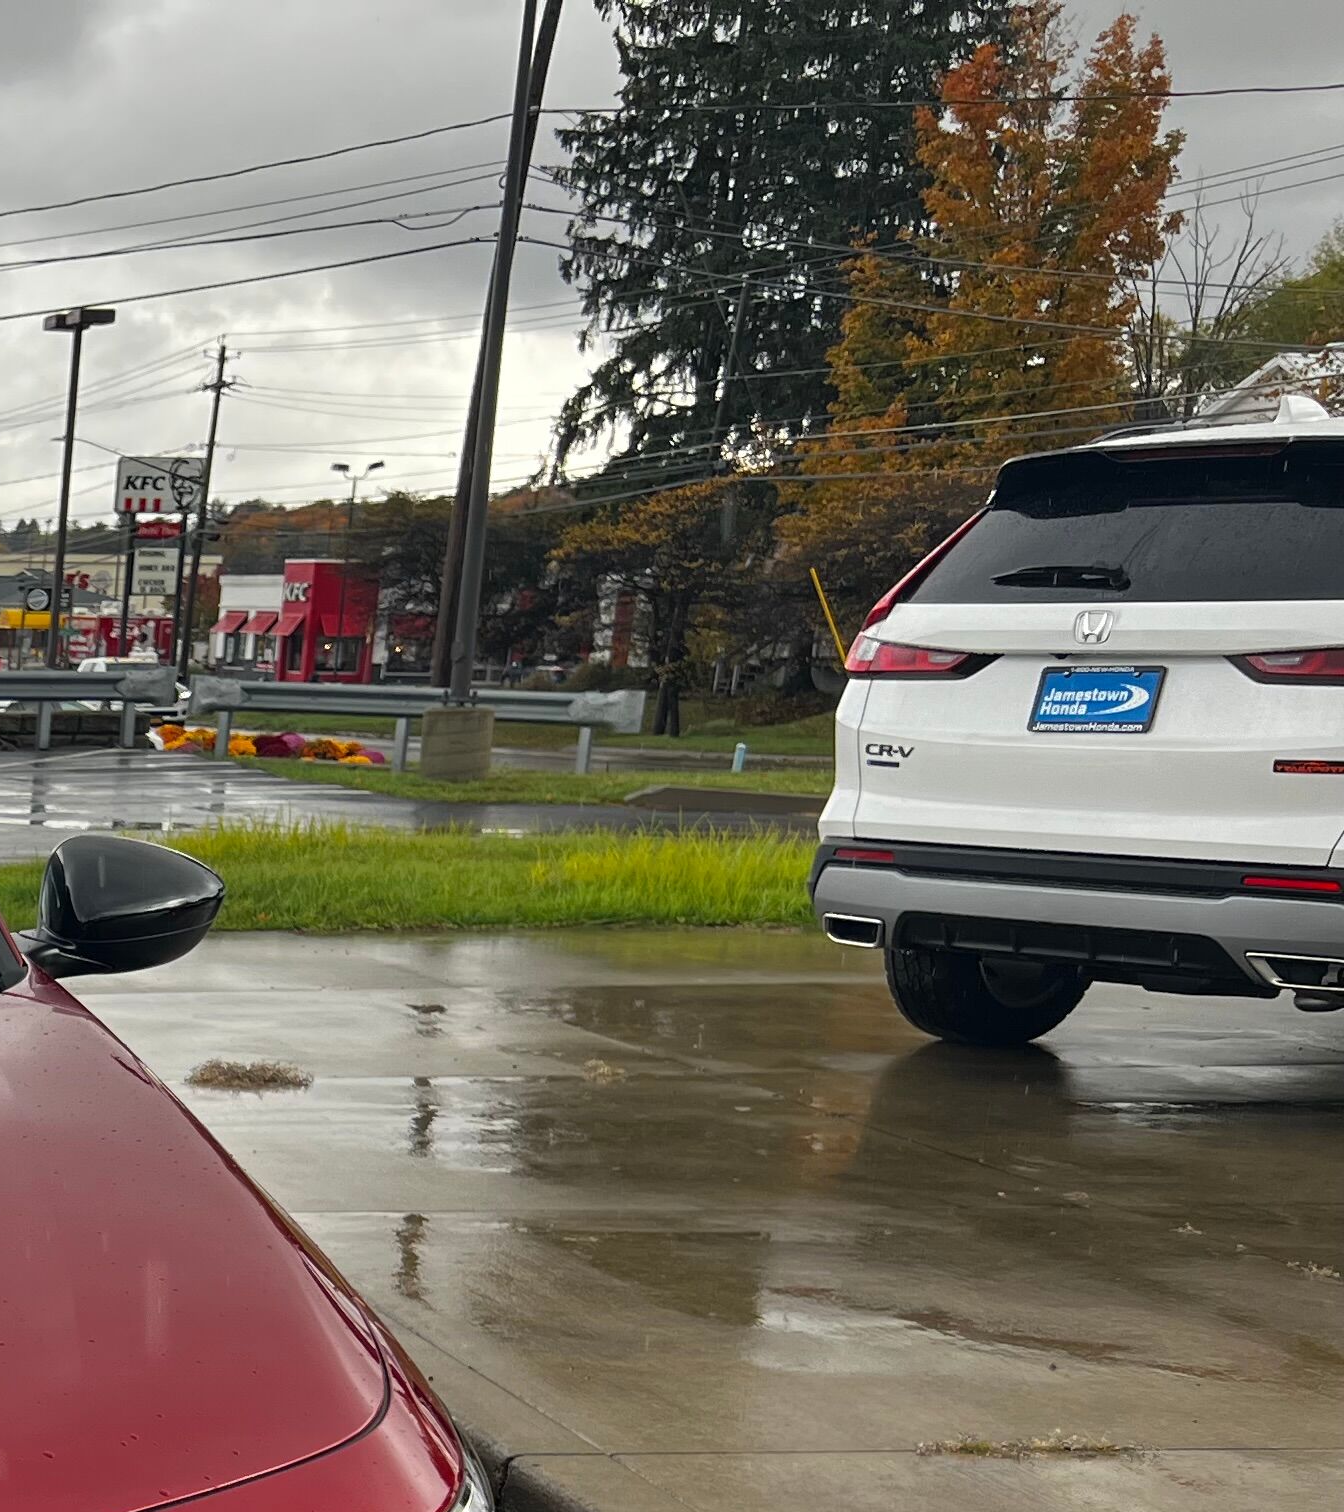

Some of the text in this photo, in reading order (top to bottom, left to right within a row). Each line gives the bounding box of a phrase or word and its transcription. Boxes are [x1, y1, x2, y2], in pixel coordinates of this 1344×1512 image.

[124, 475, 165, 491] KFC
[283, 583, 309, 601] KFC
[1044, 688, 1128, 701] Jamestown
[1040, 703, 1087, 715] Honda
[1033, 722, 1143, 731] JamestownHonda.com
[865, 743, 915, 758] CR-V
